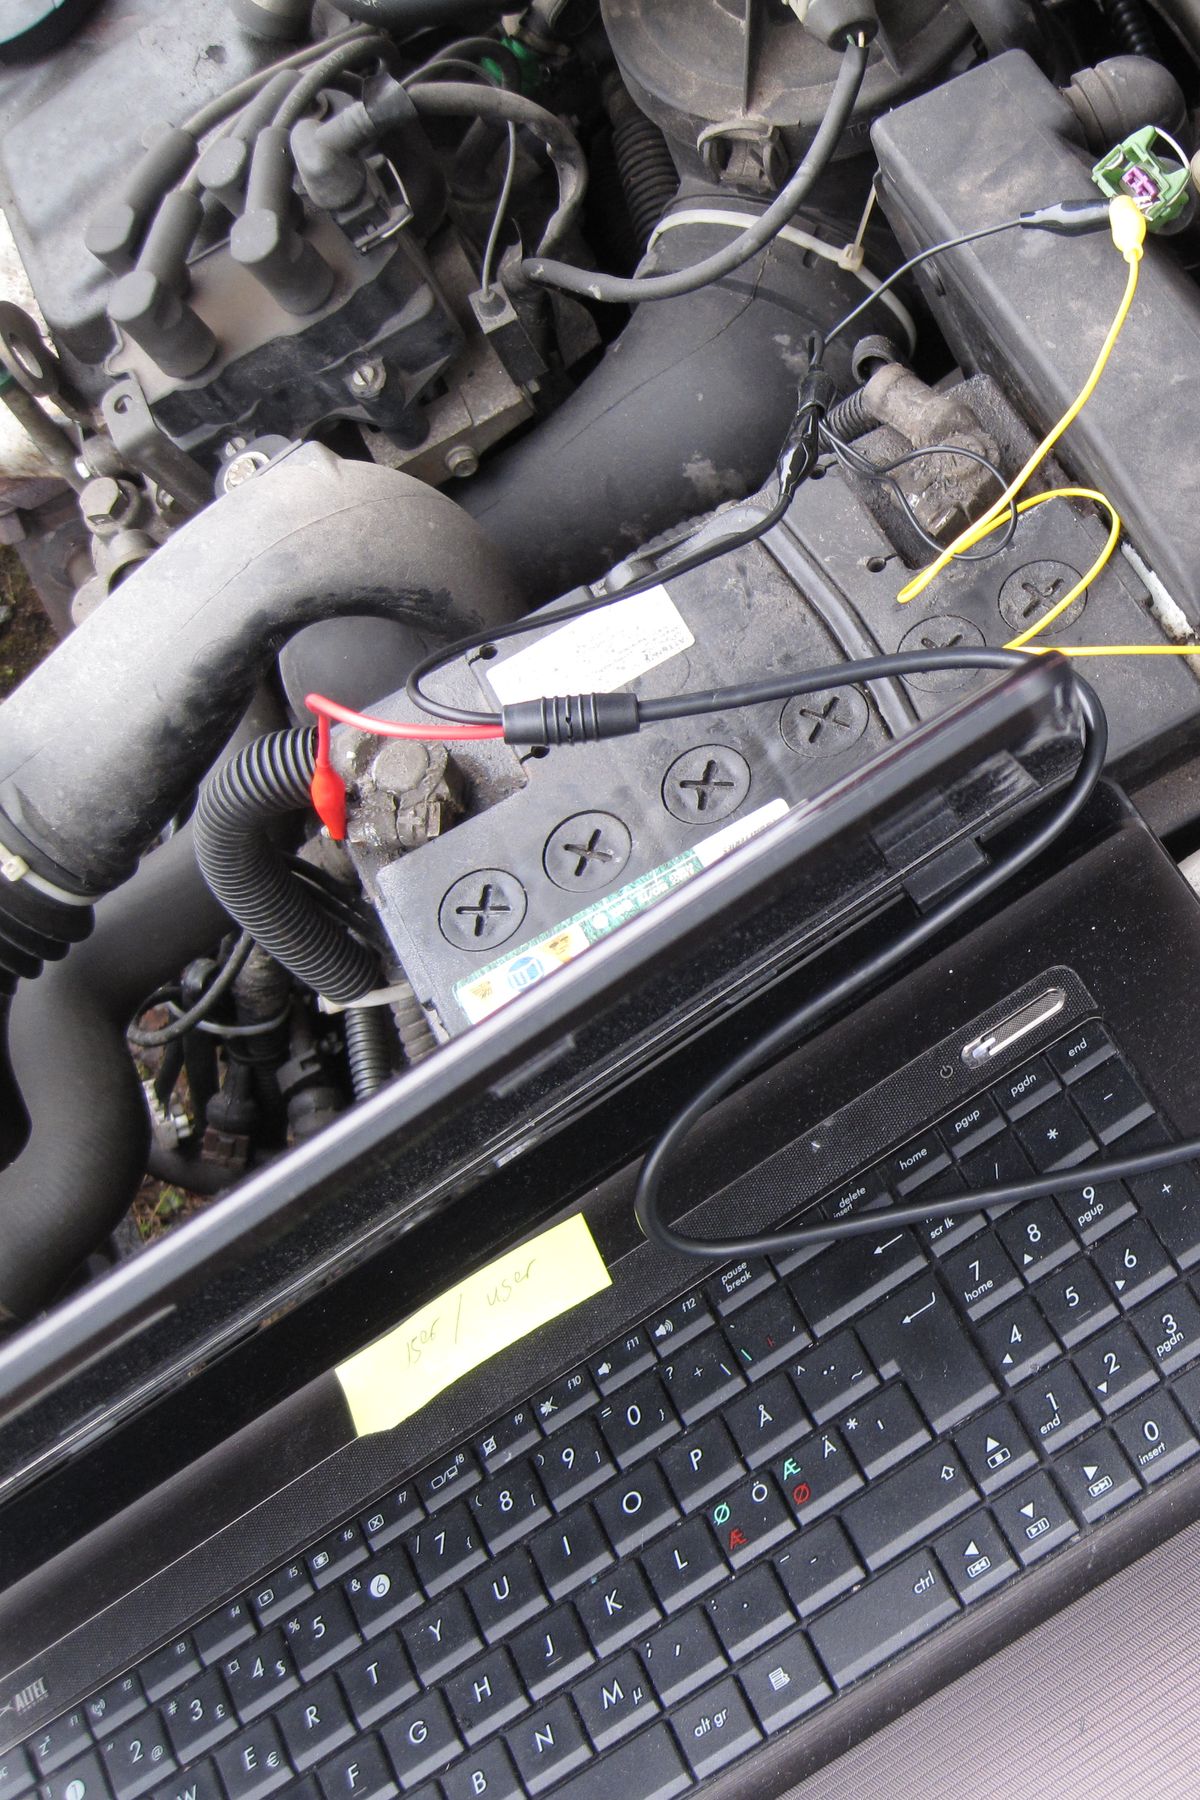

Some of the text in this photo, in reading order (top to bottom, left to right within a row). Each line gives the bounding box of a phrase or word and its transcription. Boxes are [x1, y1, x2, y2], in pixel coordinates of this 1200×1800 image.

[1069, 1038, 1087, 1056] end
[1011, 1075, 1036, 1097] pgdn
[955, 1111, 979, 1132] pgup
[900, 1149, 927, 1170] home
[838, 1186, 866, 1208] delete
[1083, 1187, 1094, 1204] 9
[1078, 1204, 1103, 1226] pgup
[931, 1226, 942, 1238] scr
[945, 1218, 954, 1228] lk
[1027, 1224, 1040, 1242] 8
[1124, 1249, 1137, 1268] 6
[721, 1261, 747, 1285] pause
[725, 1270, 752, 1293] break
[968, 1261, 980, 1281] 7
[486, 1258, 537, 1306] user
[964, 1279, 994, 1302] home
[683, 1298, 696, 1312] f12
[1066, 1287, 1078, 1306] 5
[1011, 1325, 1021, 1343] 4
[1163, 1315, 1176, 1338] 3
[627, 1337, 639, 1350] f11
[1157, 1328, 1183, 1356] pgdn
[694, 1368, 703, 1376] +
[1104, 1353, 1120, 1374] 2
[568, 1376, 581, 1389] f10
[1046, 1392, 1059, 1411] 1
[515, 1414, 523, 1424] f9
[627, 1406, 640, 1425] 0
[759, 1405, 772, 1427] Å
[1040, 1414, 1061, 1435] end
[1145, 1422, 1158, 1441] 0
[822, 1435, 836, 1458] Ä
[1139, 1442, 1166, 1465] insert
[456, 1454, 464, 1465] f8
[562, 1448, 574, 1468] 9
[691, 1449, 701, 1470] P
[783, 1458, 801, 1480] Æ
[399, 1491, 406, 1503] f7
[500, 1491, 512, 1511] 8
[752, 1481, 767, 1502] Ö
[793, 1483, 811, 1505] Ø
[623, 1492, 641, 1513] O
[713, 1502, 731, 1526] Ø
[344, 1530, 353, 1540] f6
[435, 1532, 444, 1554] 7
[675, 1550, 687, 1569] L
[289, 1566, 297, 1578] f5
[915, 1571, 934, 1593] ctrl
[350, 1578, 362, 1592] &
[374, 1575, 387, 1595] 6
[493, 1576, 509, 1599] U
[231, 1606, 240, 1617] f4
[605, 1590, 622, 1615] K
[289, 1619, 300, 1633] %
[314, 1616, 325, 1638] 5
[429, 1620, 440, 1641] Y
[176, 1643, 185, 1654] f3
[546, 1635, 553, 1657] J
[253, 1658, 264, 1677] 4
[276, 1659, 287, 1677] $
[367, 1663, 377, 1684] T
[123, 1680, 132, 1691] f2
[474, 1677, 491, 1702] H
[603, 1680, 623, 1709] M
[168, 1702, 176, 1715] #
[191, 1700, 202, 1720] 3
[216, 1704, 224, 1718] £
[306, 1706, 320, 1727] R
[409, 1721, 426, 1743] G
[695, 1708, 729, 1737] alt gr
[535, 1725, 553, 1752] N
[130, 1741, 142, 1763] 2
[152, 1746, 162, 1761] @
[244, 1747, 256, 1770] E
[267, 1752, 279, 1767] €
[348, 1764, 358, 1787] F
[472, 1772, 486, 1794] B
[177, 1784, 197, 1800] W
